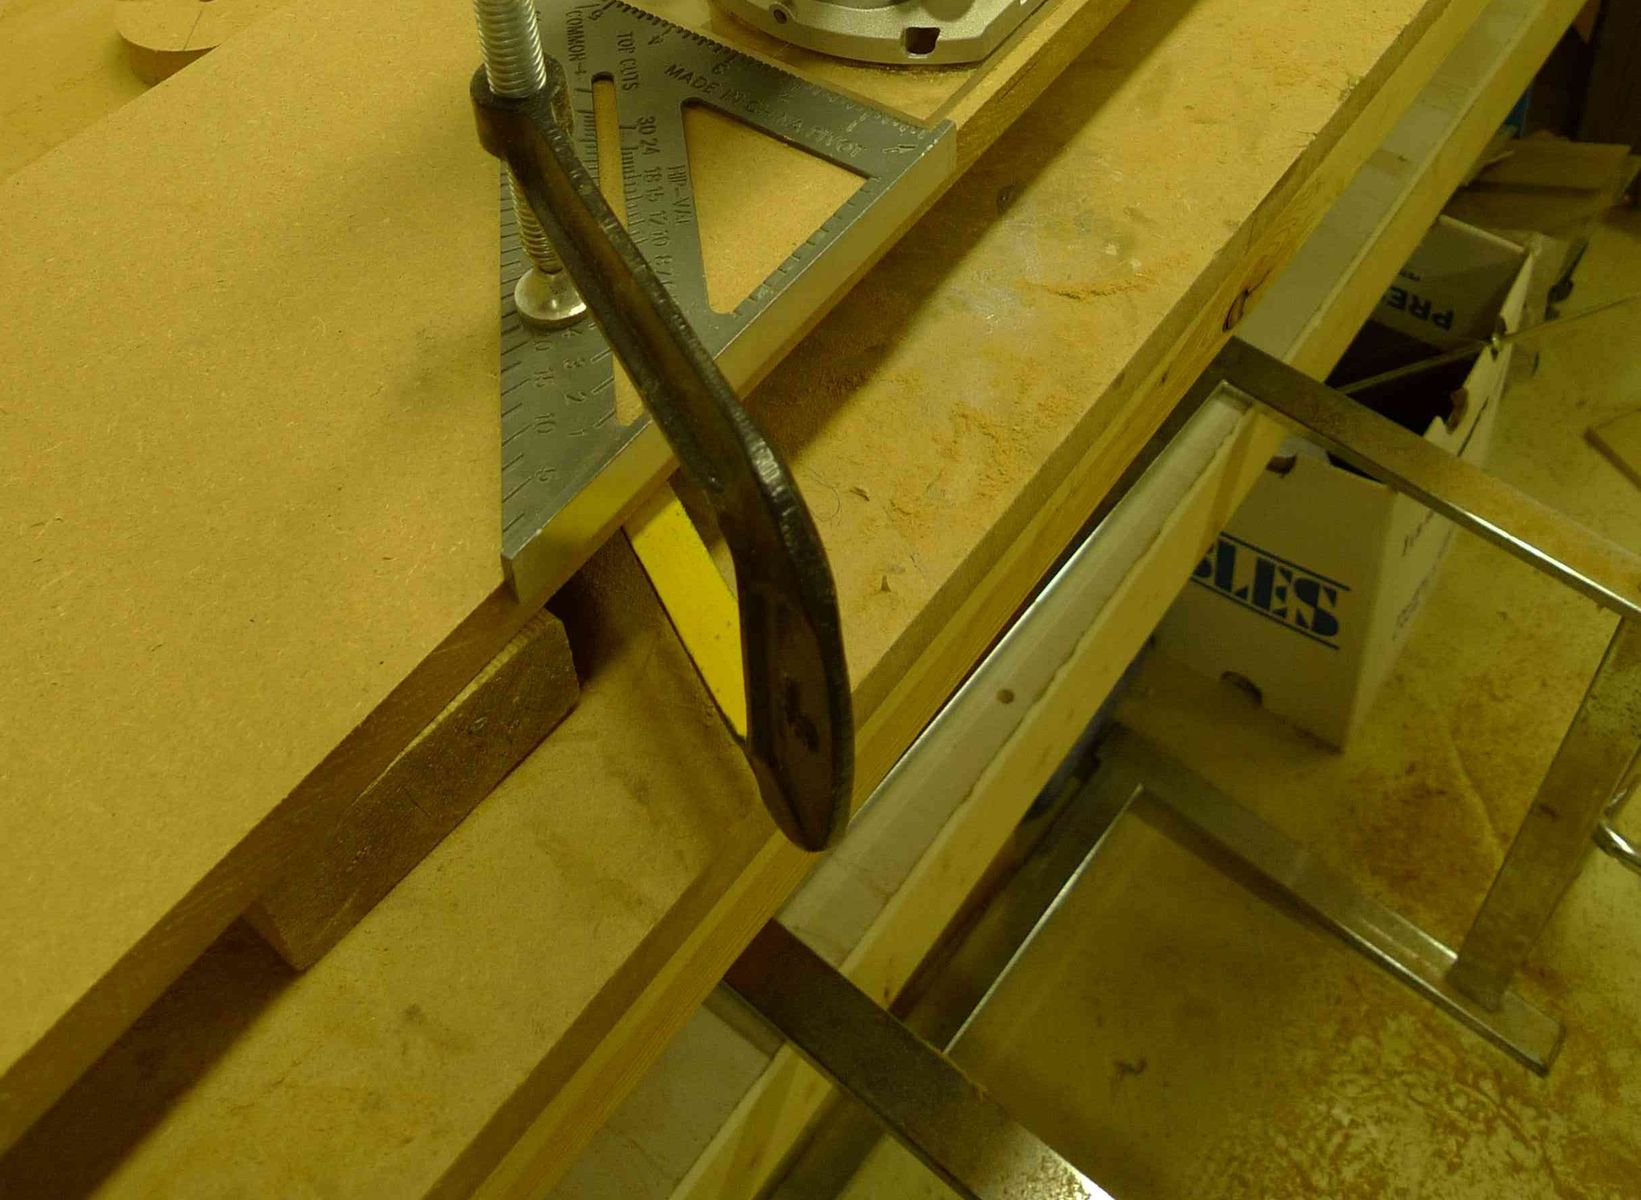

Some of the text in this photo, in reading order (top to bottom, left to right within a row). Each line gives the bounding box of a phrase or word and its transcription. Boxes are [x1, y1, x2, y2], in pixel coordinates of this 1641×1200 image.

[617, 31, 641, 91] TOP CUTS
[664, 64, 722, 93] MADE
[638, 115, 656, 135] 30
[534, 412, 556, 434] 10
